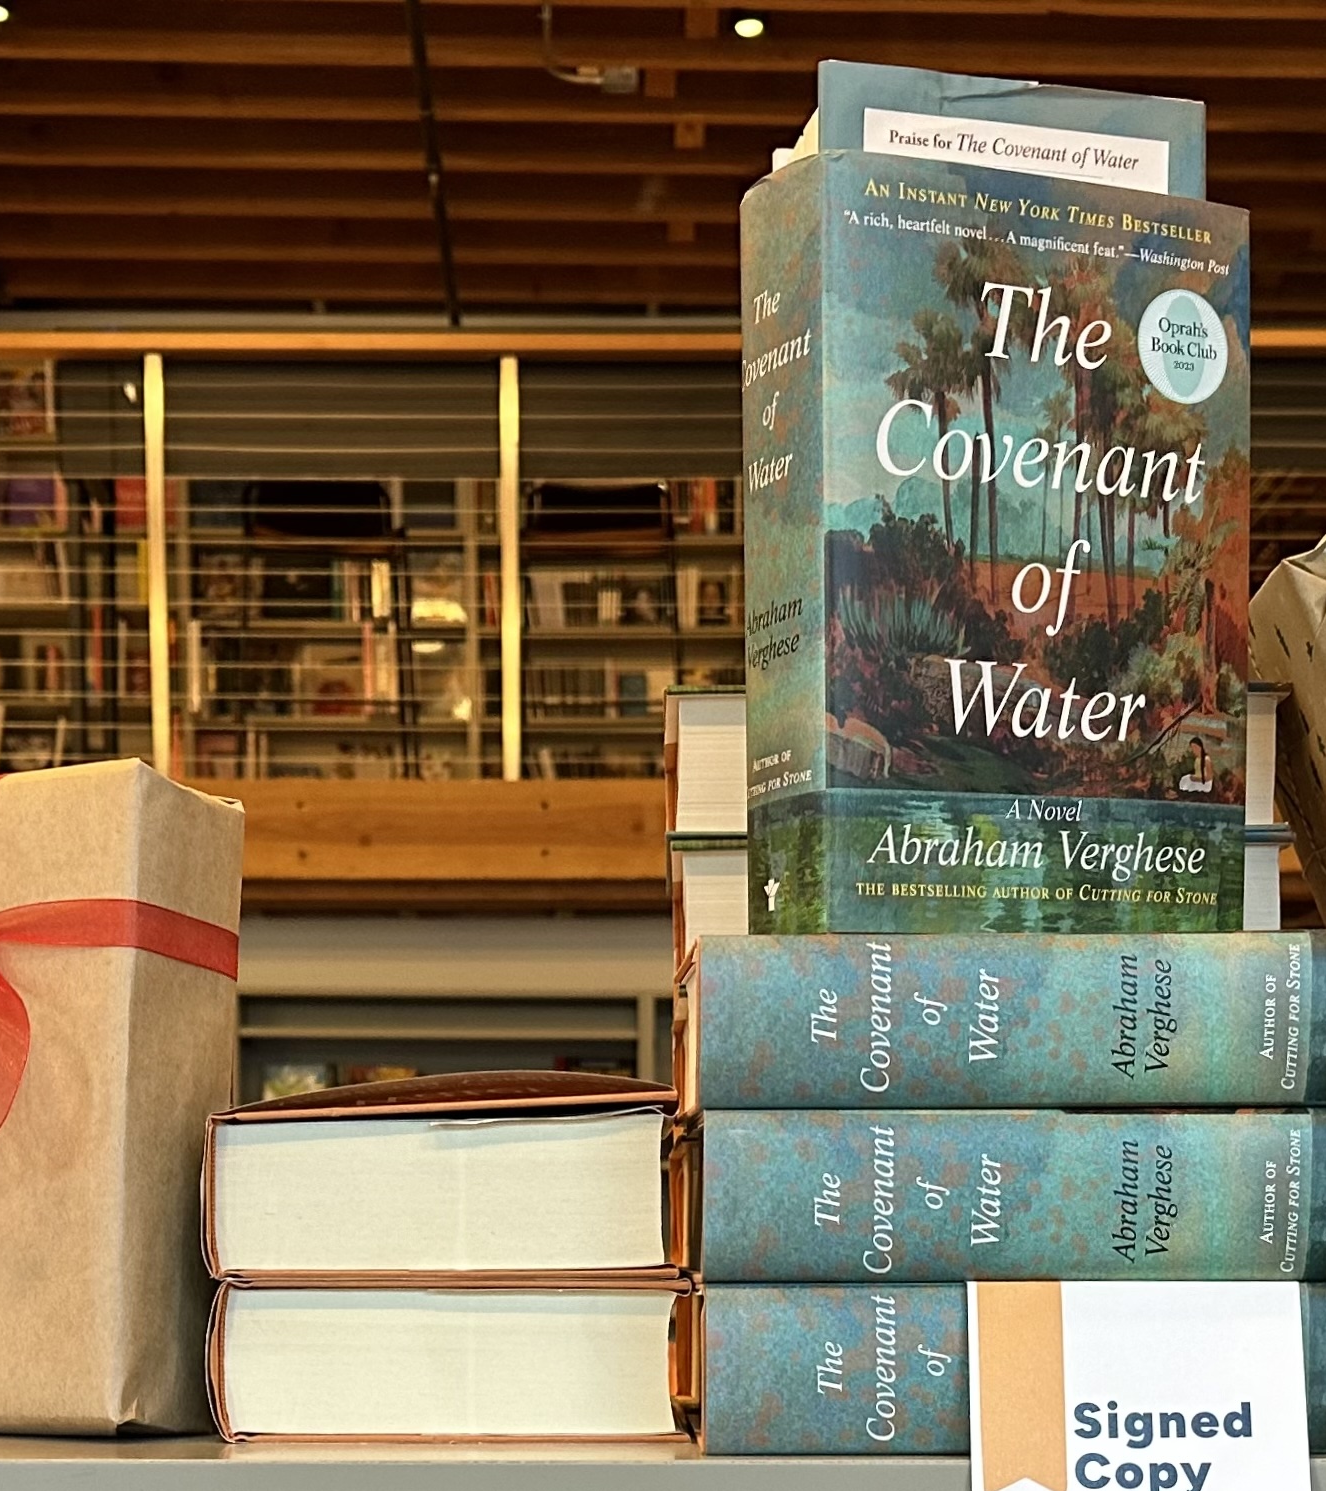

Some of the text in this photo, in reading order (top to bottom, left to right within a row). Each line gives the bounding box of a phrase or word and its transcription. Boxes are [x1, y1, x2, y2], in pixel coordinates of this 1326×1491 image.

[889, 129, 1139, 172] Praise for The Covenant of Water
[898, 182, 967, 208] INSTANT
[975, 193, 1012, 214] NEW
[1018, 198, 1060, 221] YORK
[1068, 205, 1114, 230] TIMES
[1122, 213, 1211, 244] BESTSELLER
[981, 281, 1112, 370] The
[1151, 336, 1217, 361] Book Club
[1173, 360, 1195, 372] 2023
[876, 399, 1206, 504] Covenant
[1011, 539, 1090, 637] of
[944, 658, 1146, 743] Water
[1006, 800, 1082, 822] A Novel
[867, 823, 1206, 884] Abraham Verghese
[856, 882, 1218, 906] THE BESTSELLING AUTHOR OF CUTTING FOR STONE
[810, 987, 839, 1045] The
[860, 942, 893, 1094] Covenant
[923, 992, 948, 1028] of
[969, 969, 1001, 1065] Water
[1074, 1401, 1254, 1448] Signed
